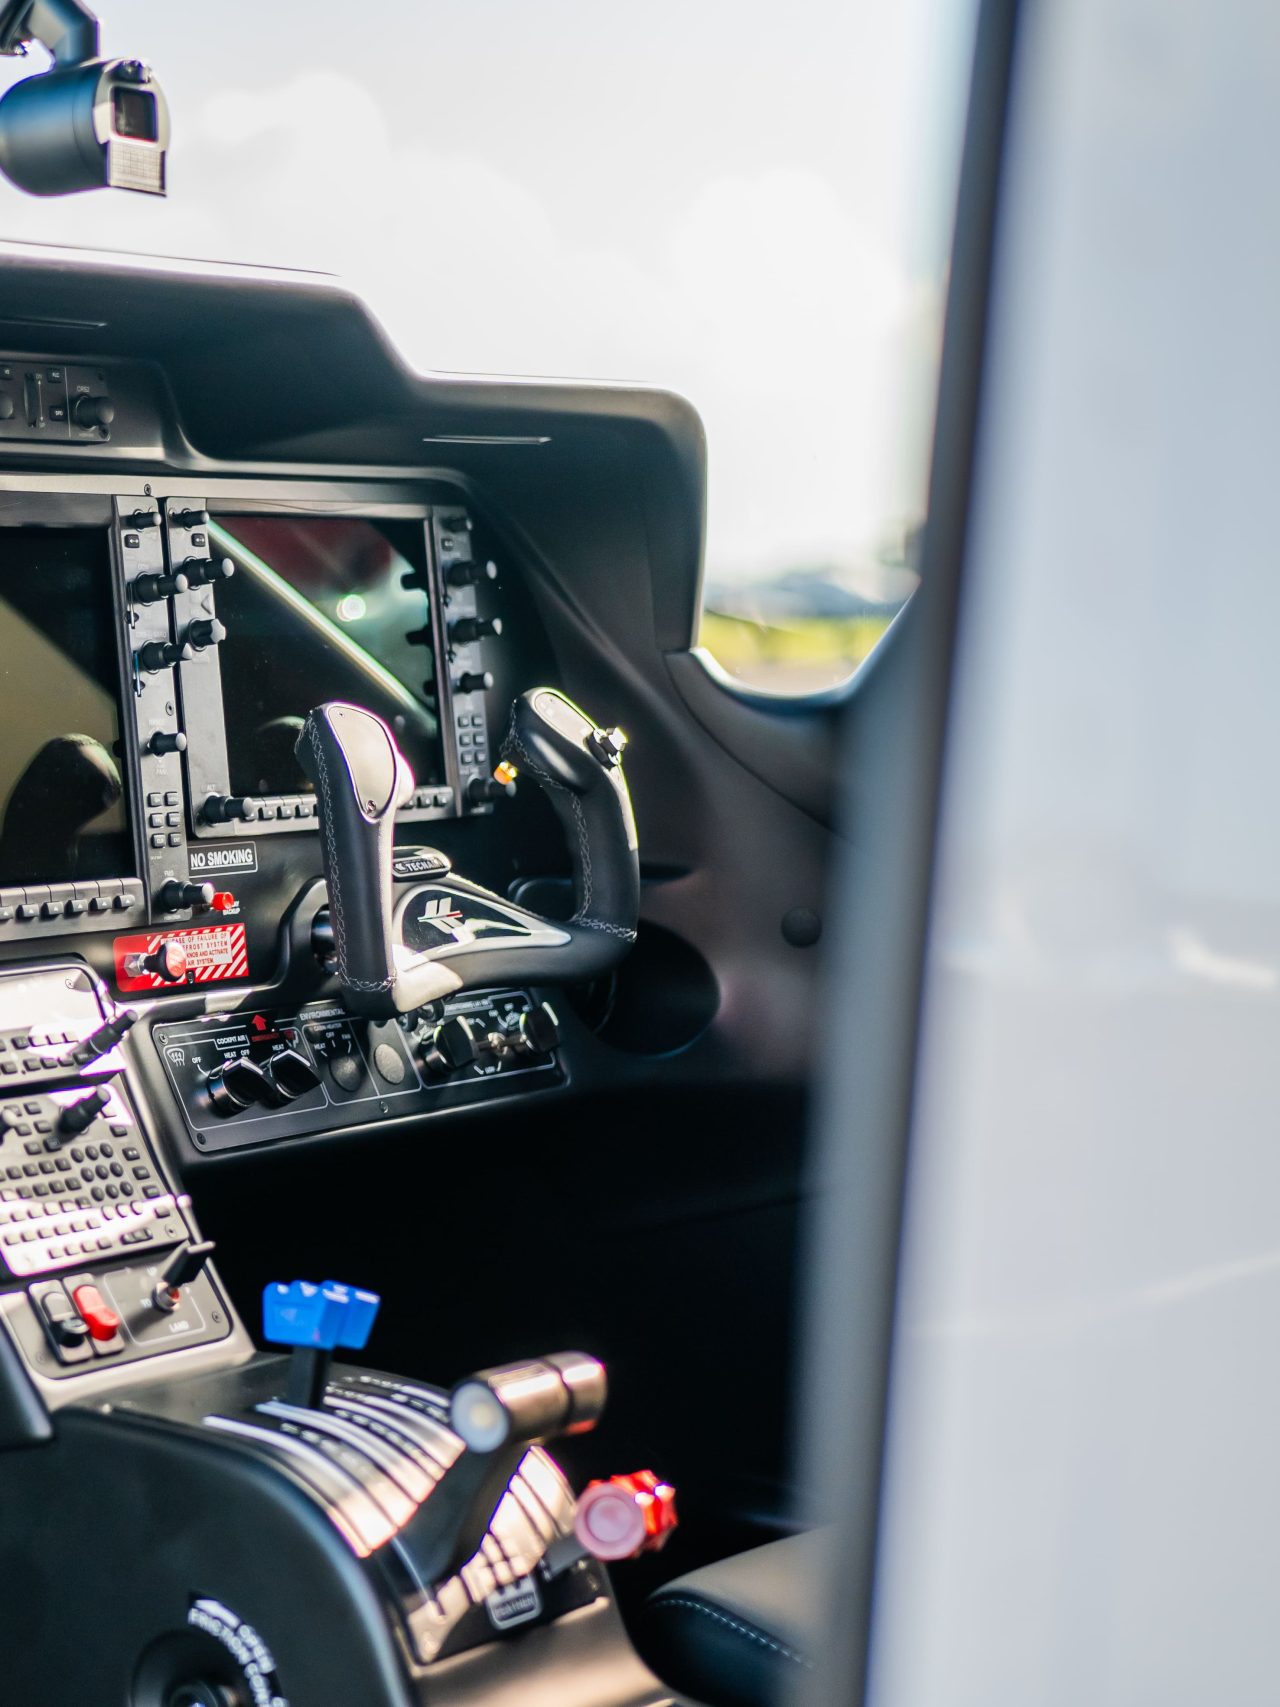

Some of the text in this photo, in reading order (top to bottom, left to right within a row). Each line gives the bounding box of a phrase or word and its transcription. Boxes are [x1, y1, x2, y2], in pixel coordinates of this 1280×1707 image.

[190, 848, 253, 867] NO SMOKING
[405, 859, 439, 872] TECNA
[197, 934, 218, 942] FAILURE
[186, 951, 199, 959] KNOB
[208, 947, 229, 956] ACTIVATE
[299, 1008, 346, 1021] ENVIRONMENTAL
[216, 1034, 246, 1045] COCKPIT AIR
[325, 1031, 335, 1039] OFF
[271, 1043, 285, 1052] HEAT
[223, 1051, 237, 1059] HEAT
[240, 1049, 250, 1057] OFF
[191, 1056, 202, 1065] OFF
